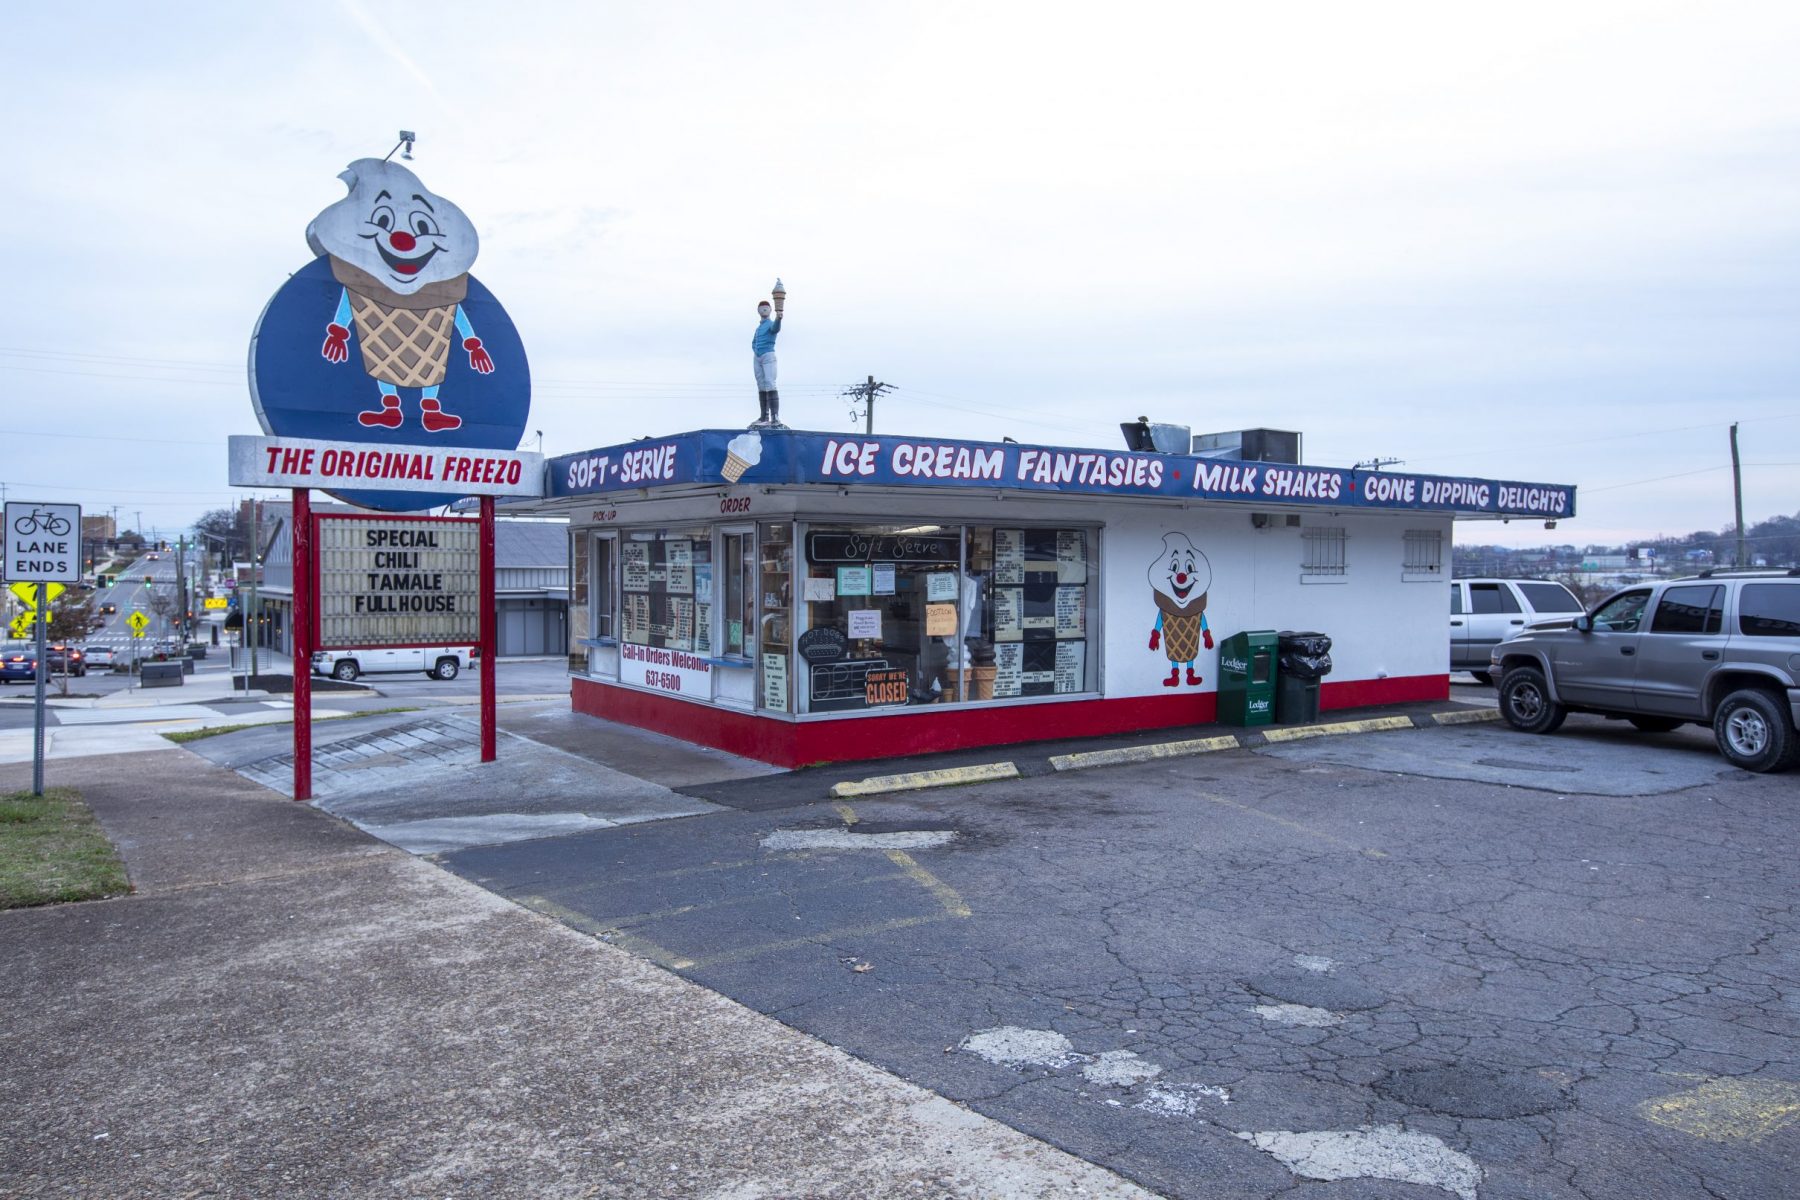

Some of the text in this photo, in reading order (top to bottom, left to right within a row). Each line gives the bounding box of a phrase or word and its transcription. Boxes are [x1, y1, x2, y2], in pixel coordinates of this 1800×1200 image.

[266, 447, 522, 485] THE ORIGINAL FREEZO
[567, 456, 608, 489] SOFT
[620, 444, 677, 483] SERVE
[821, 440, 1163, 488] ICE CREAM FANTASIES
[1193, 463, 1342, 499] MILK SHAKES
[1364, 475, 1565, 513] CONE DIPPING DELIGHTS
[720, 496, 751, 514] ORDER
[592, 510, 617, 521] PICK-UP
[16, 541, 68, 554] LANE
[366, 530, 438, 547] SPECIAL
[845, 534, 939, 560] Soft Serve
[16, 560, 68, 573] ENDS
[374, 552, 418, 569] CHILI
[367, 573, 442, 591] TAMALE
[802, 629, 821, 644] HOT
[645, 647, 670, 666] Orders
[671, 651, 709, 672] Welcome
[1221, 656, 1247, 669] Ledger
[645, 669, 681, 691] 637-6500
[813, 663, 875, 699] OPE
[867, 671, 906, 682] SORRY WE'RE
[867, 682, 907, 704] CLOSED
[1249, 699, 1269, 710] Ledger
